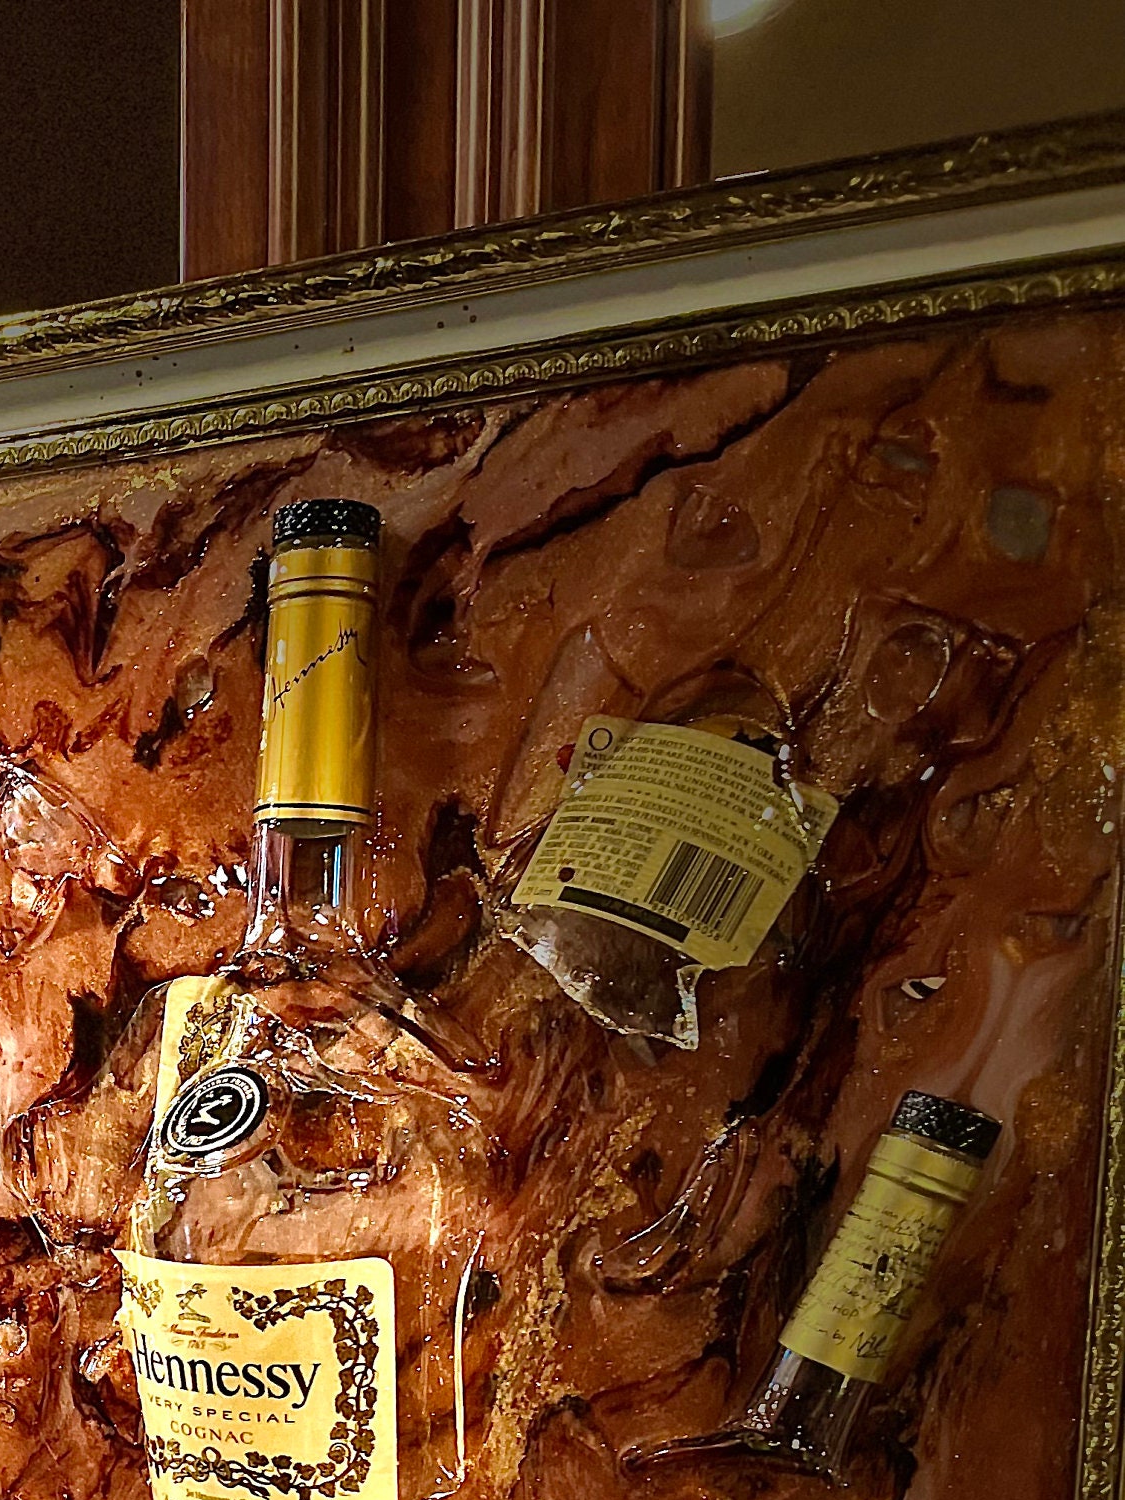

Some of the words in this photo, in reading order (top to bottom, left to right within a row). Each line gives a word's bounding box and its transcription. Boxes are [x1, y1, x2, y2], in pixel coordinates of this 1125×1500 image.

[687, 745, 745, 768] EXPRESSIVE
[748, 765, 770, 779] AND
[683, 775, 725, 794] UNIQUE
[709, 773, 747, 792] CREATE
[132, 1328, 321, 1410] Hennessy
[147, 1393, 183, 1412] VERY
[192, 1406, 296, 1424] SPECIAL
[170, 1420, 254, 1446] COGNAC
